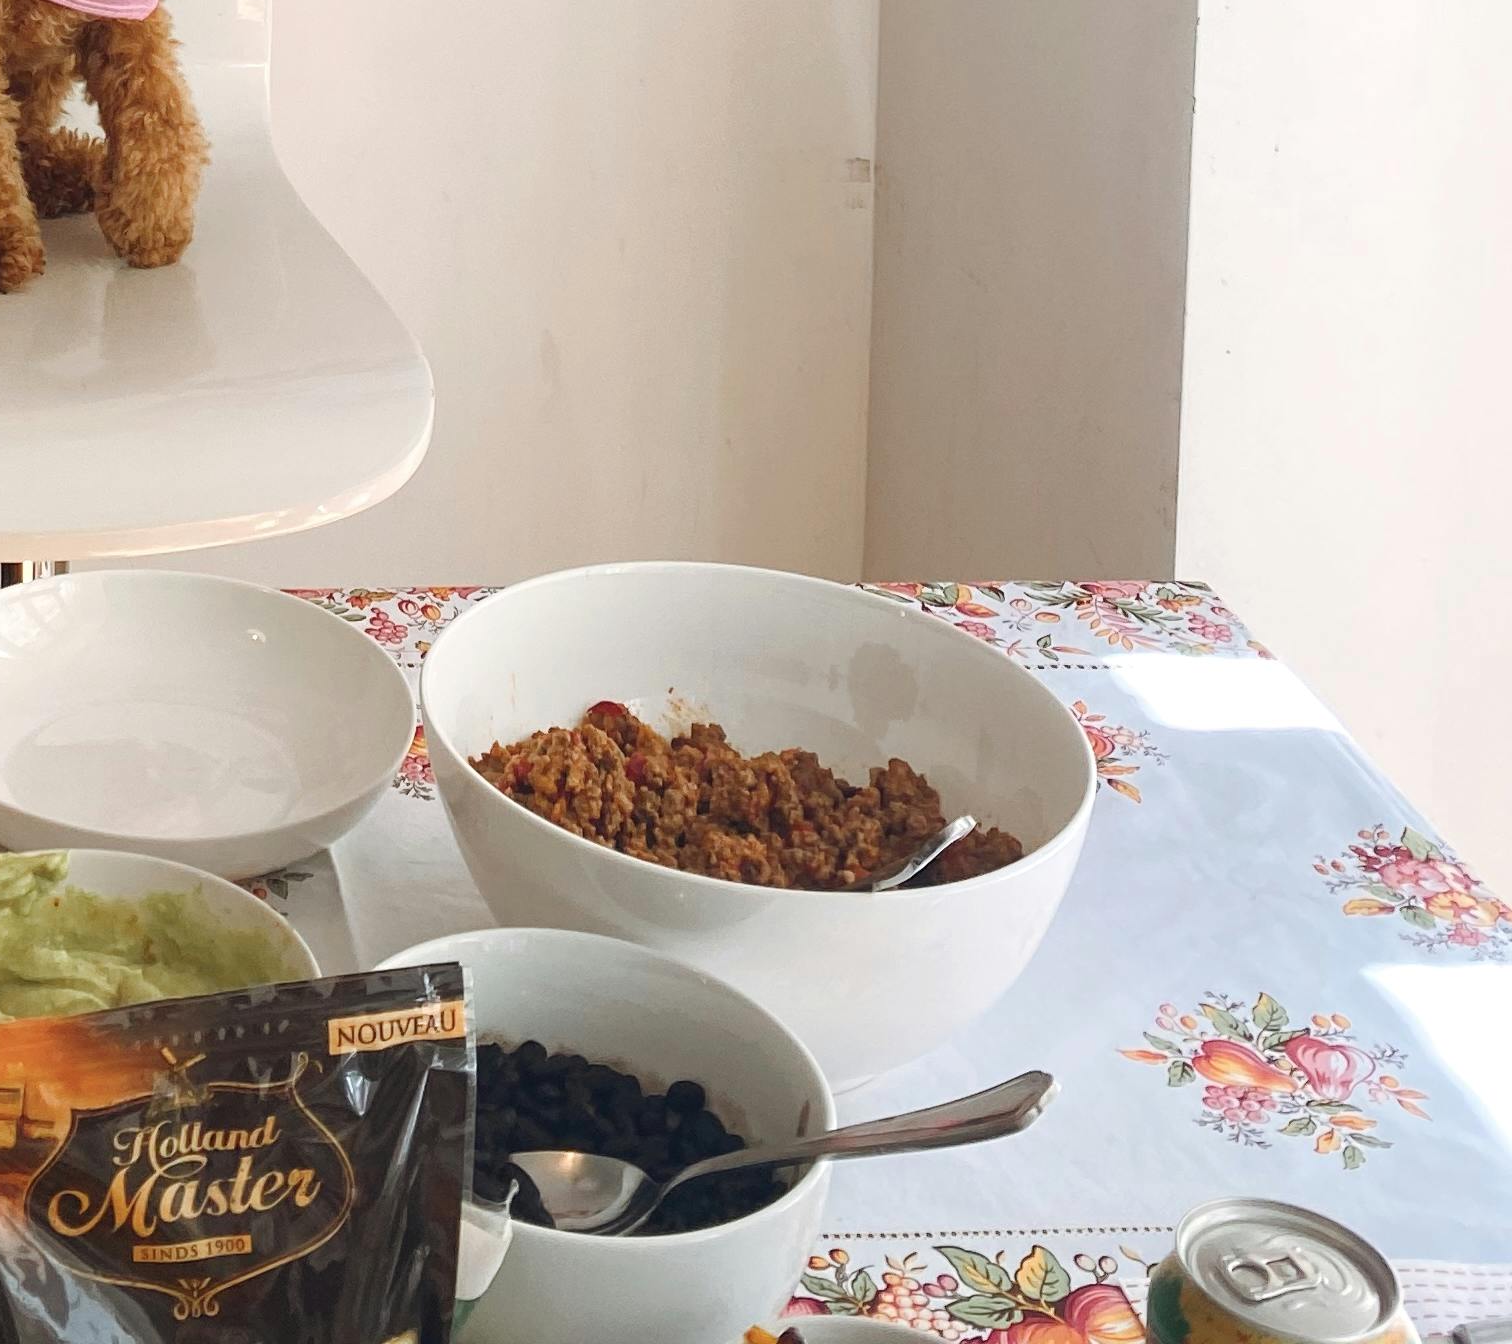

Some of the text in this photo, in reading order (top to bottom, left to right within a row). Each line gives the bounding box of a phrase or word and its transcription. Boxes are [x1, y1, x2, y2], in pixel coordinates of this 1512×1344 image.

[337, 1009, 456, 1047] NOUVEAU
[112, 1115, 282, 1166] Holland
[48, 1155, 320, 1237] Master
[141, 1238, 245, 1261] SINDS 1900
